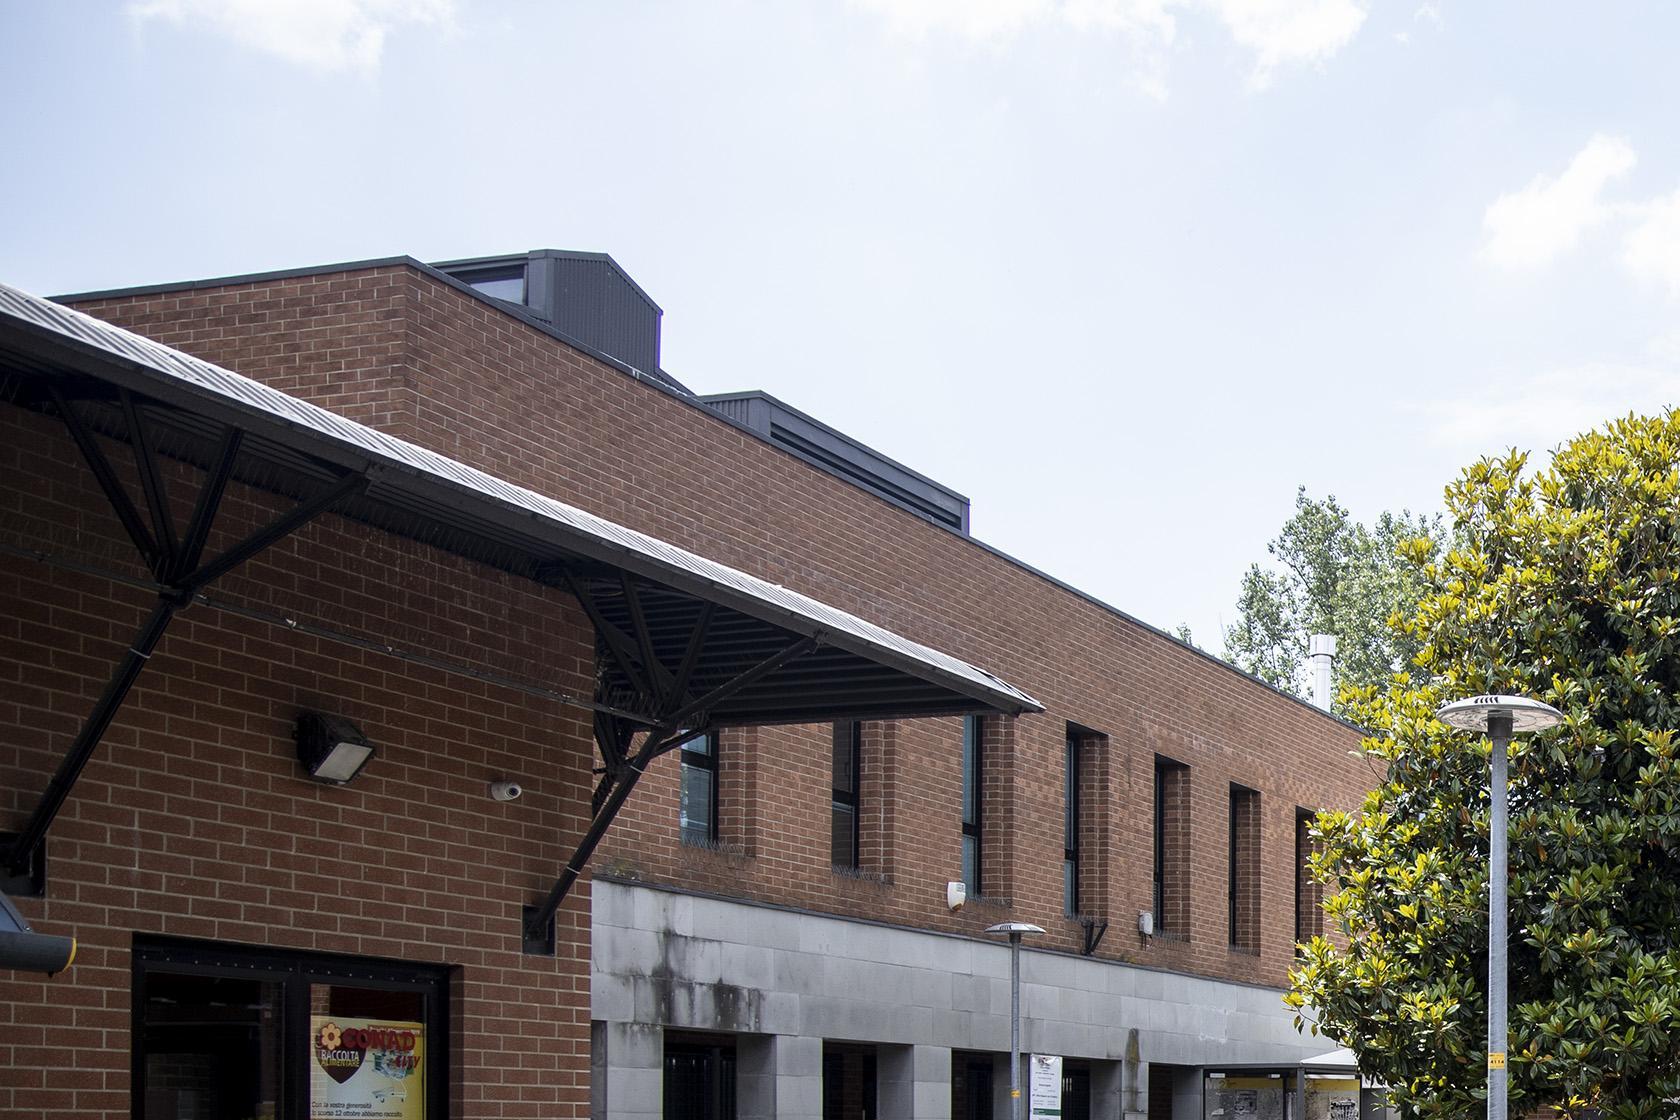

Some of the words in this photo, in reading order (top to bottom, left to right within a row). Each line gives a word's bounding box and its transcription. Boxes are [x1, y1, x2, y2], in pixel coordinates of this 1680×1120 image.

[341, 1029, 415, 1051] CONAD
[321, 1049, 360, 1061] RACCOLTA
[395, 1055, 421, 1068] CITY
